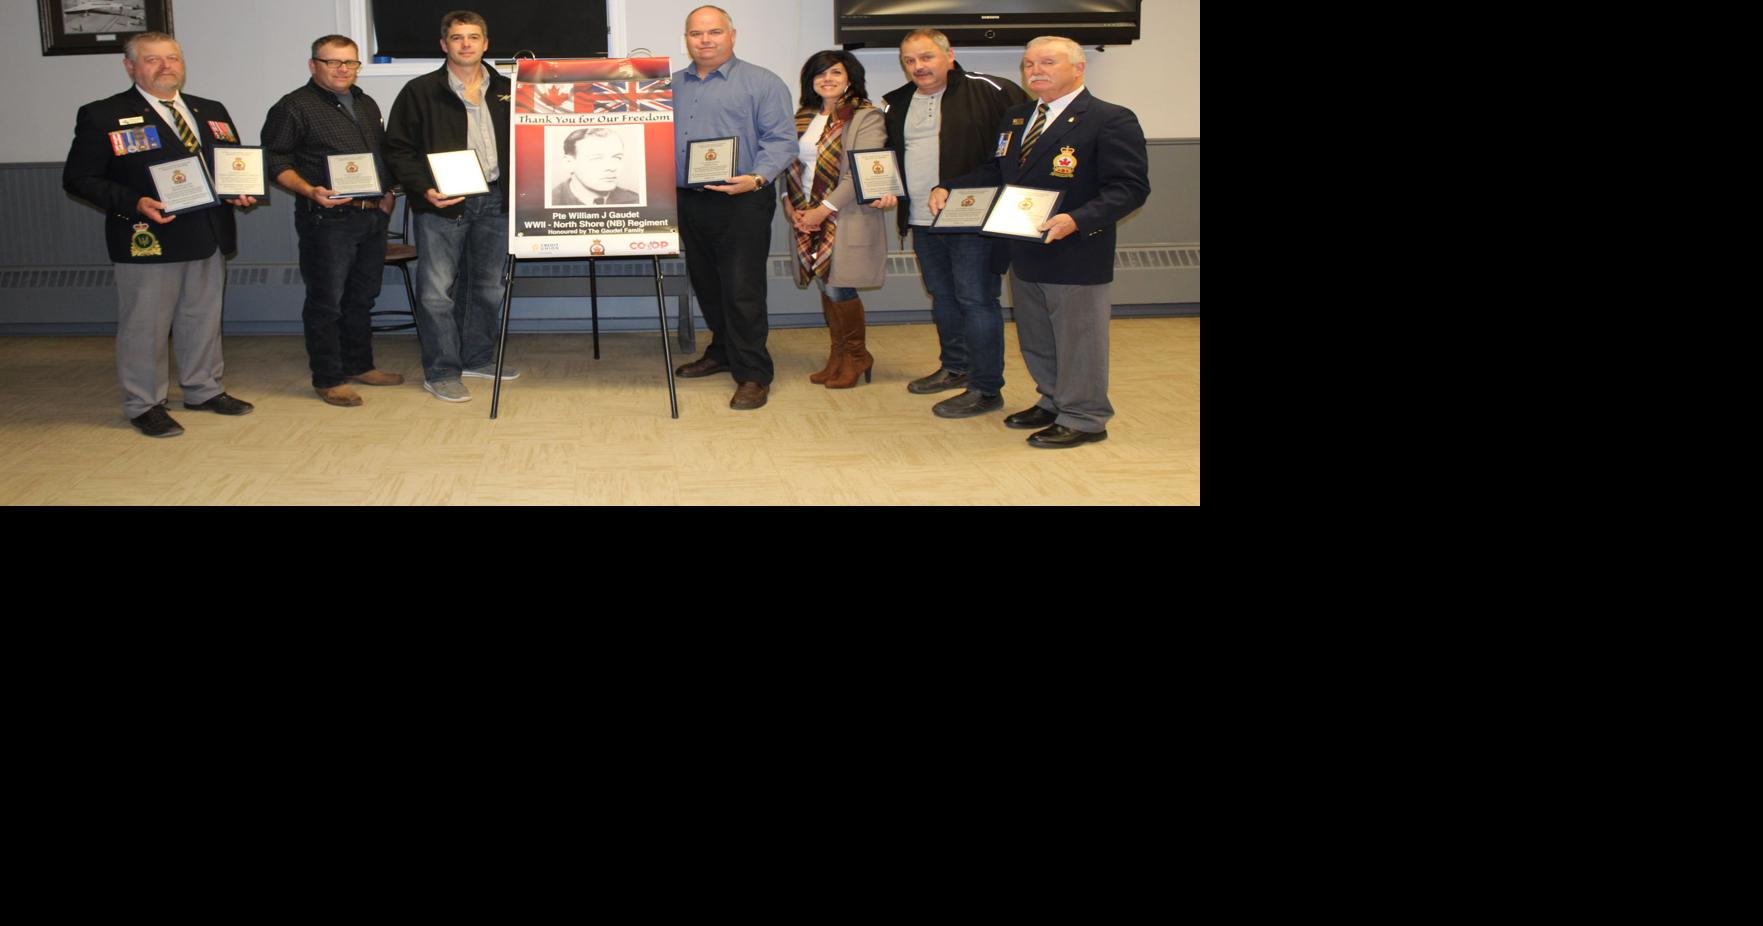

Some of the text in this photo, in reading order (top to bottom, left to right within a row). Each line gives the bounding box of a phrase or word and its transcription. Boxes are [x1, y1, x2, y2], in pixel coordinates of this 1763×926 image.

[519, 112, 671, 124] Thank You for Our Freedom
[552, 211, 640, 220] Pte William J Gaudet
[524, 221, 546, 229] WWII
[553, 220, 577, 228] North
[579, 220, 605, 228] Shore
[606, 219, 626, 228] (NB)
[627, 219, 669, 228] Regiment
[578, 228, 587, 236] by
